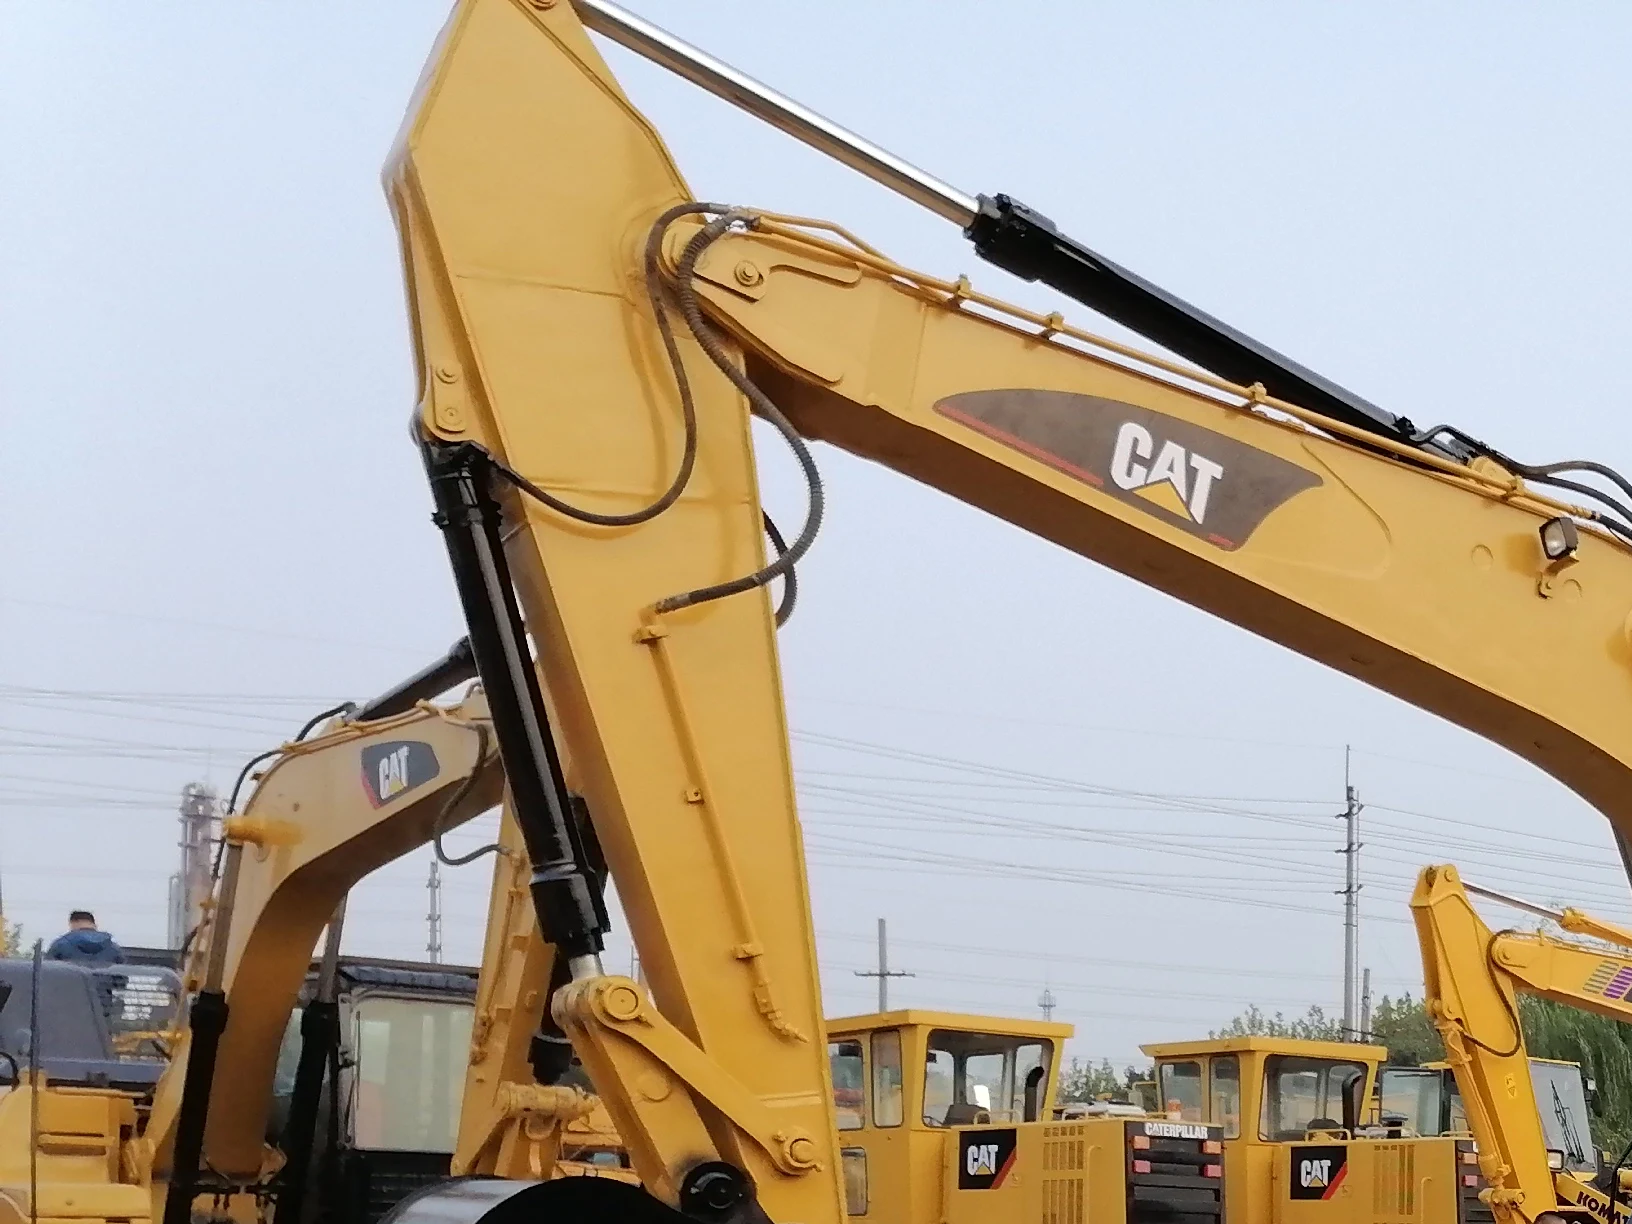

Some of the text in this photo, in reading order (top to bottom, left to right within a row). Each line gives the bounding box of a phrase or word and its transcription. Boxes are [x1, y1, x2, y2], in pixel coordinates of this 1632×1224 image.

[1111, 422, 1224, 525] CAT
[379, 745, 409, 800] CAT
[1144, 1122, 1208, 1139] CATERPILLAR
[967, 1144, 999, 1176] CAT
[1300, 1159, 1332, 1188] CAT
